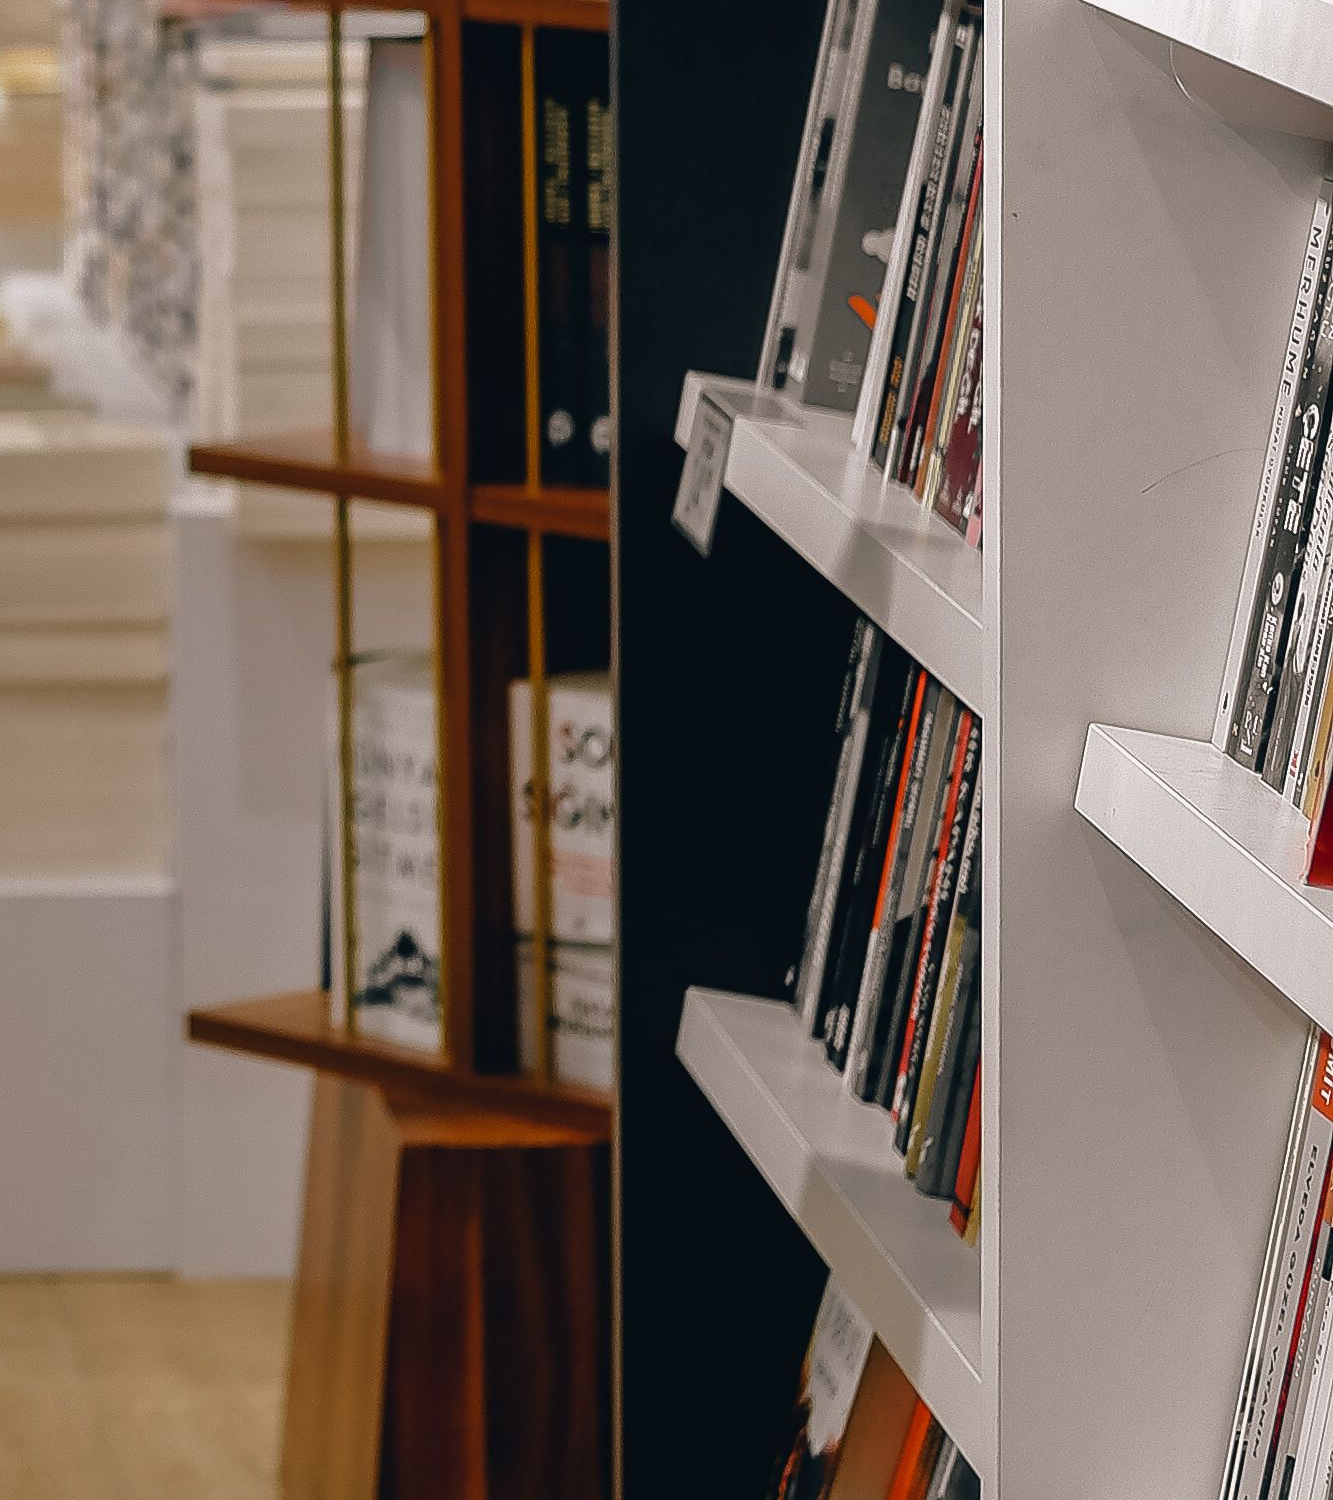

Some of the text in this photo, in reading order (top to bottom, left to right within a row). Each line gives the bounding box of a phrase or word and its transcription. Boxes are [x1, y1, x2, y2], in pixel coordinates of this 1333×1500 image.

[1279, 225, 1323, 397] MERHUME
[1251, 1143, 1318, 1459] ELVEDA GÜZEL VATANIM
